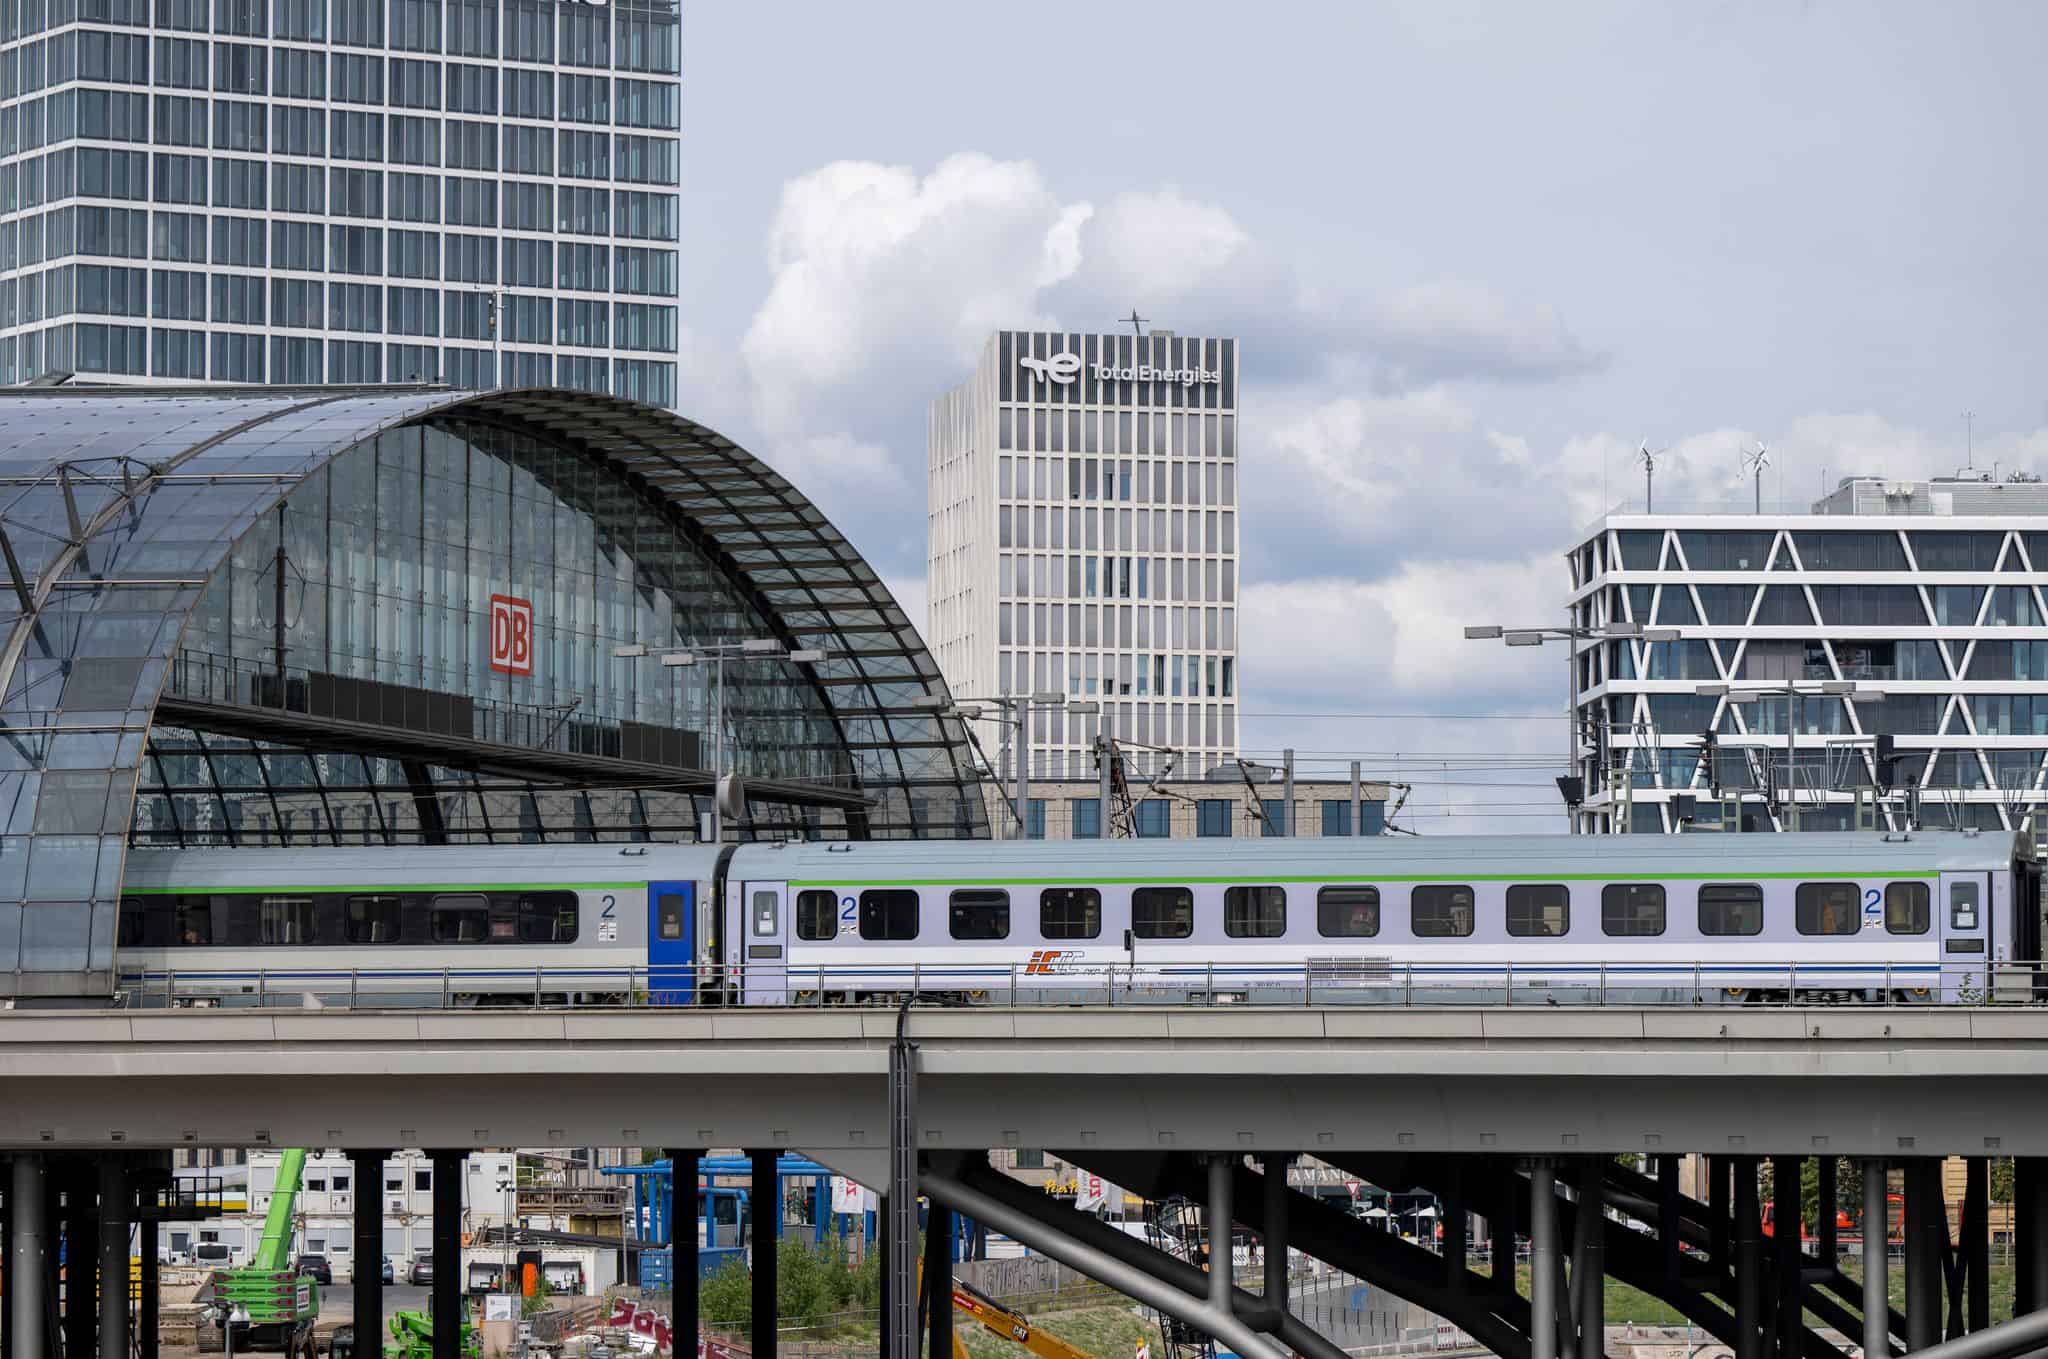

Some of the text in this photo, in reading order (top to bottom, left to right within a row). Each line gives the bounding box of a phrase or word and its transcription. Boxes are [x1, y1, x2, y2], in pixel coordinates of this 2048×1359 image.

[1090, 363, 1220, 387] TotalEnergies
[495, 607, 528, 663] DB
[601, 895, 616, 918] 2
[841, 896, 857, 920] 2
[1864, 889, 1881, 914] 2
[1012, 1325, 1027, 1341] CAT
